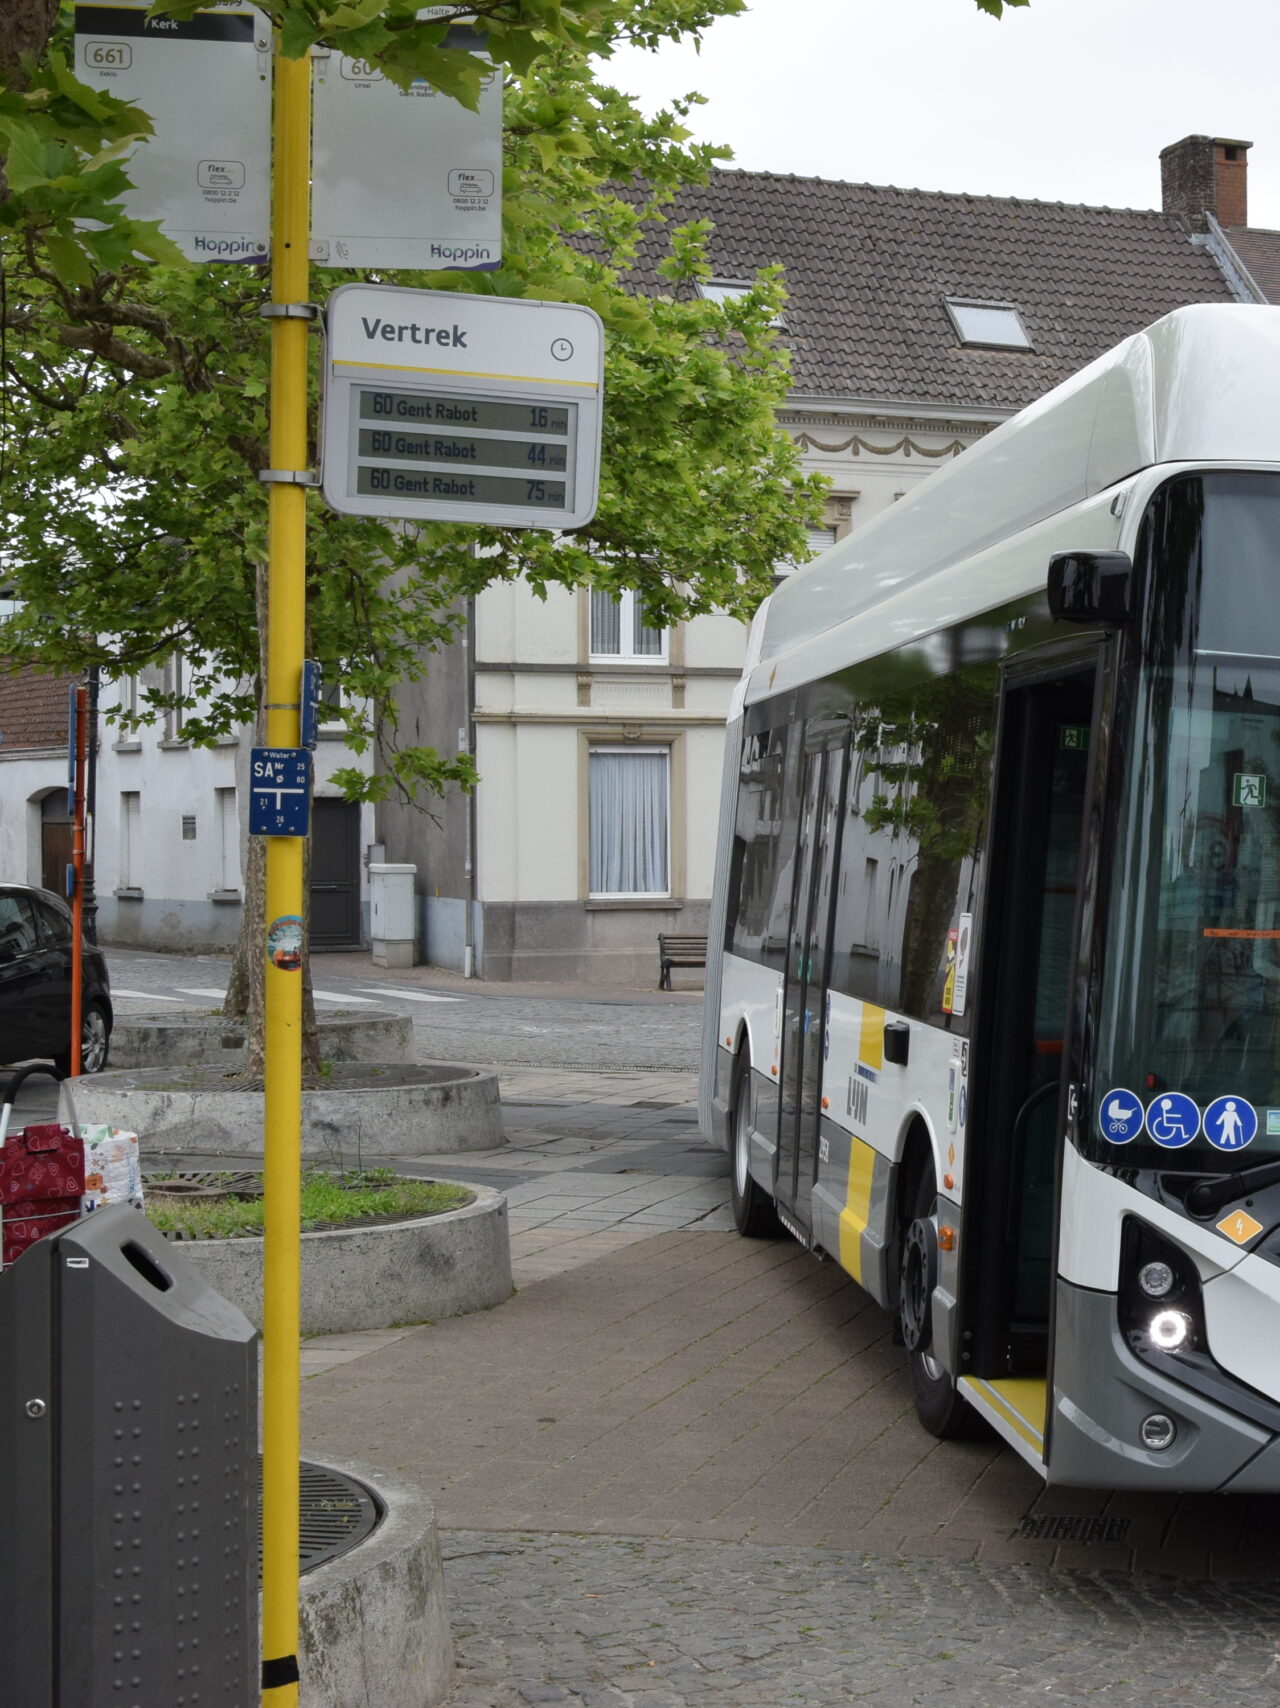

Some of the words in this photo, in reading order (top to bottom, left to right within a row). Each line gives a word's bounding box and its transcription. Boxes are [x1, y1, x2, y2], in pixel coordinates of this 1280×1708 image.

[427, 7, 450, 16] Halte
[151, 19, 179, 30] Kerk
[93, 48, 124, 64] 661
[207, 164, 225, 173] flex
[458, 173, 475, 181] flex
[430, 243, 490, 262] Hoppin
[361, 317, 468, 348] Vertrek
[373, 394, 393, 415] 60
[397, 400, 432, 418] Gent
[435, 403, 478, 422] Rabot
[530, 407, 548, 428] 16
[372, 432, 391, 452] 60
[395, 438, 430, 456] Gent
[434, 441, 477, 459] Rabot
[527, 444, 546, 466] 44
[370, 469, 390, 490] 60
[394, 475, 429, 493] Gent
[432, 478, 475, 496] Rabot
[526, 480, 545, 501] 75
[254, 762, 274, 777] SA
[275, 762, 285, 770] Nr
